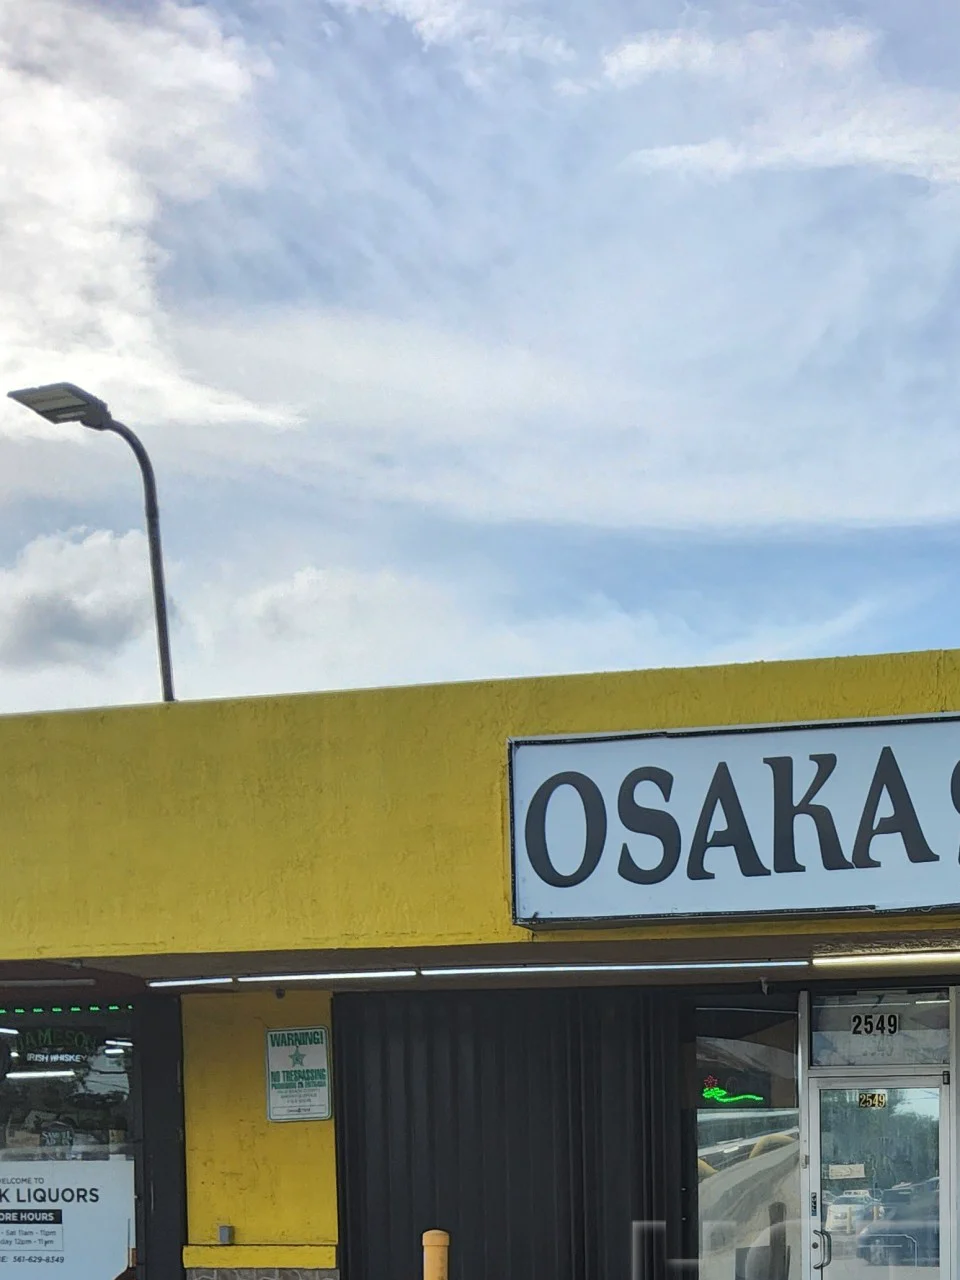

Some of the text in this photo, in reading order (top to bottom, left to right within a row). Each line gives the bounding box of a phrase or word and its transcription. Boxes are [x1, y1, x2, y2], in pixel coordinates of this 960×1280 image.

[524, 746, 940, 888] OSAKA
[852, 1014, 897, 1035] 2549
[270, 1031, 323, 1047] WARNING!
[27, 1052, 88, 1063] IRISH WHISKEY
[859, 1093, 886, 1108] 2549
[34, 1177, 45, 1185] TO
[16, 1187, 100, 1203] LIQUORS
[20, 1212, 55, 1221] HOURS
